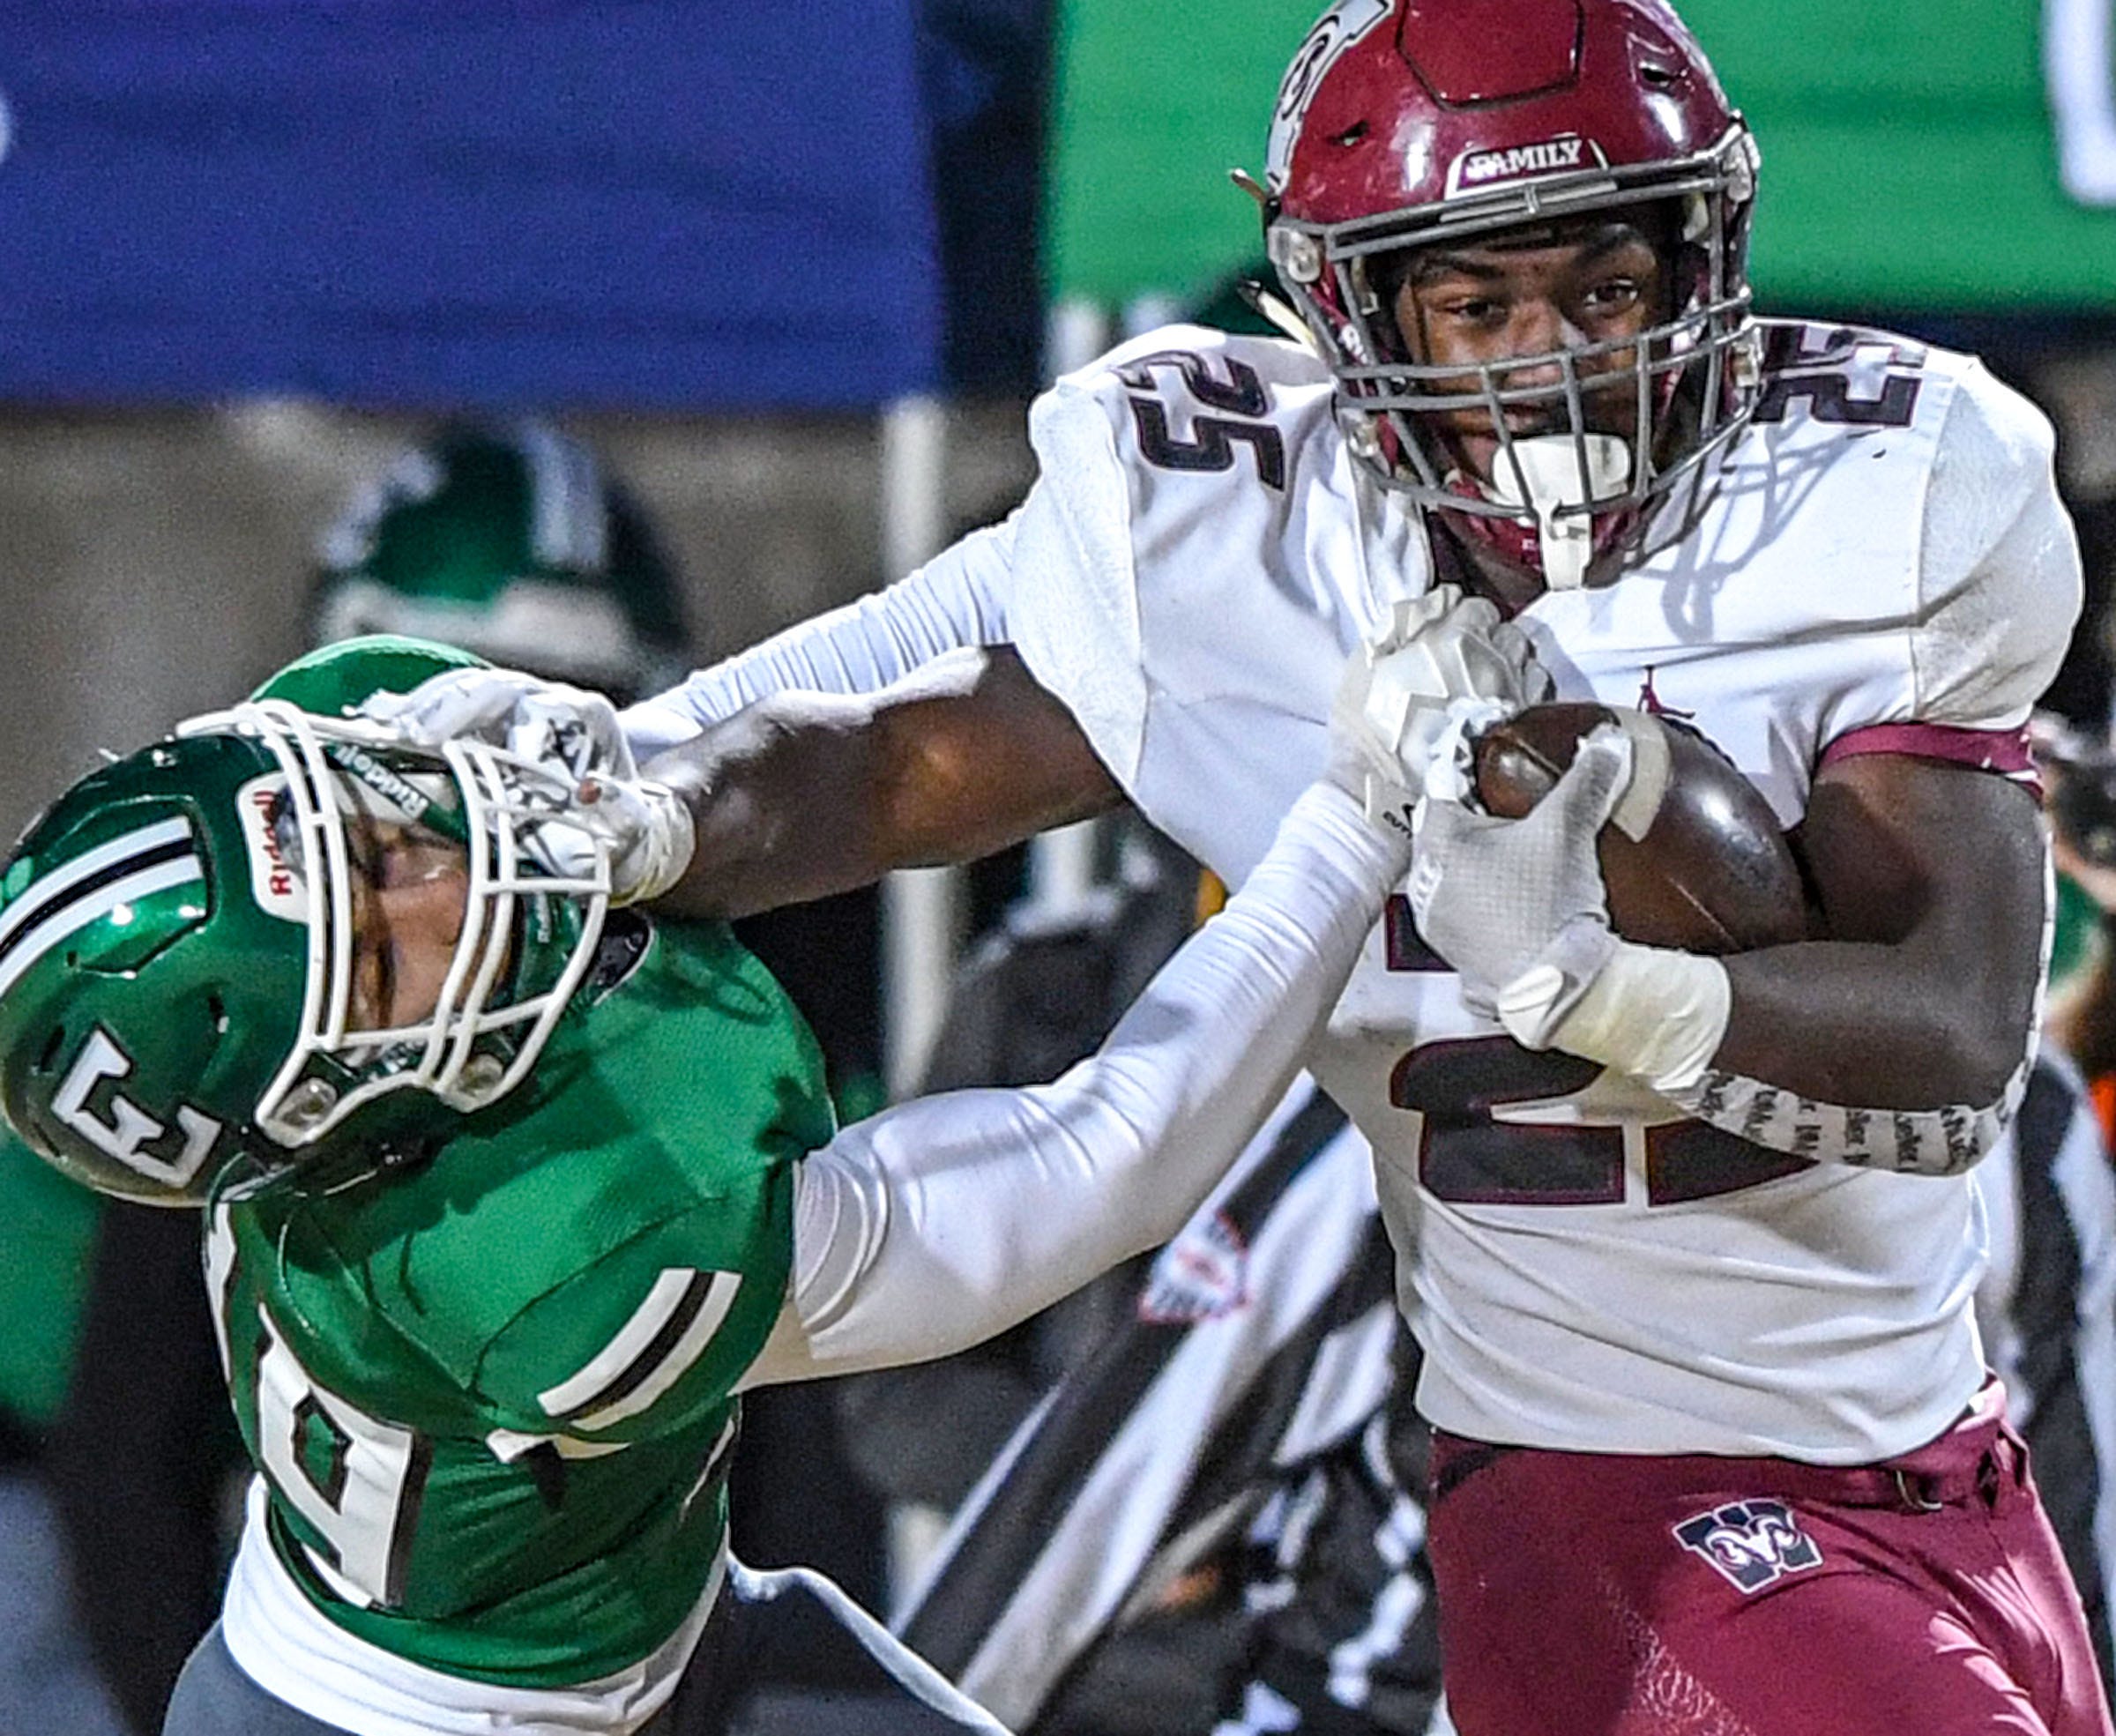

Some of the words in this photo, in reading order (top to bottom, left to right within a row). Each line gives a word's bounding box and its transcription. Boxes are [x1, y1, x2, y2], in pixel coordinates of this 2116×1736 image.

[1464, 138, 1583, 181] FAMILY
[1113, 350, 1287, 492] 25
[50, 1024, 223, 1188] E
